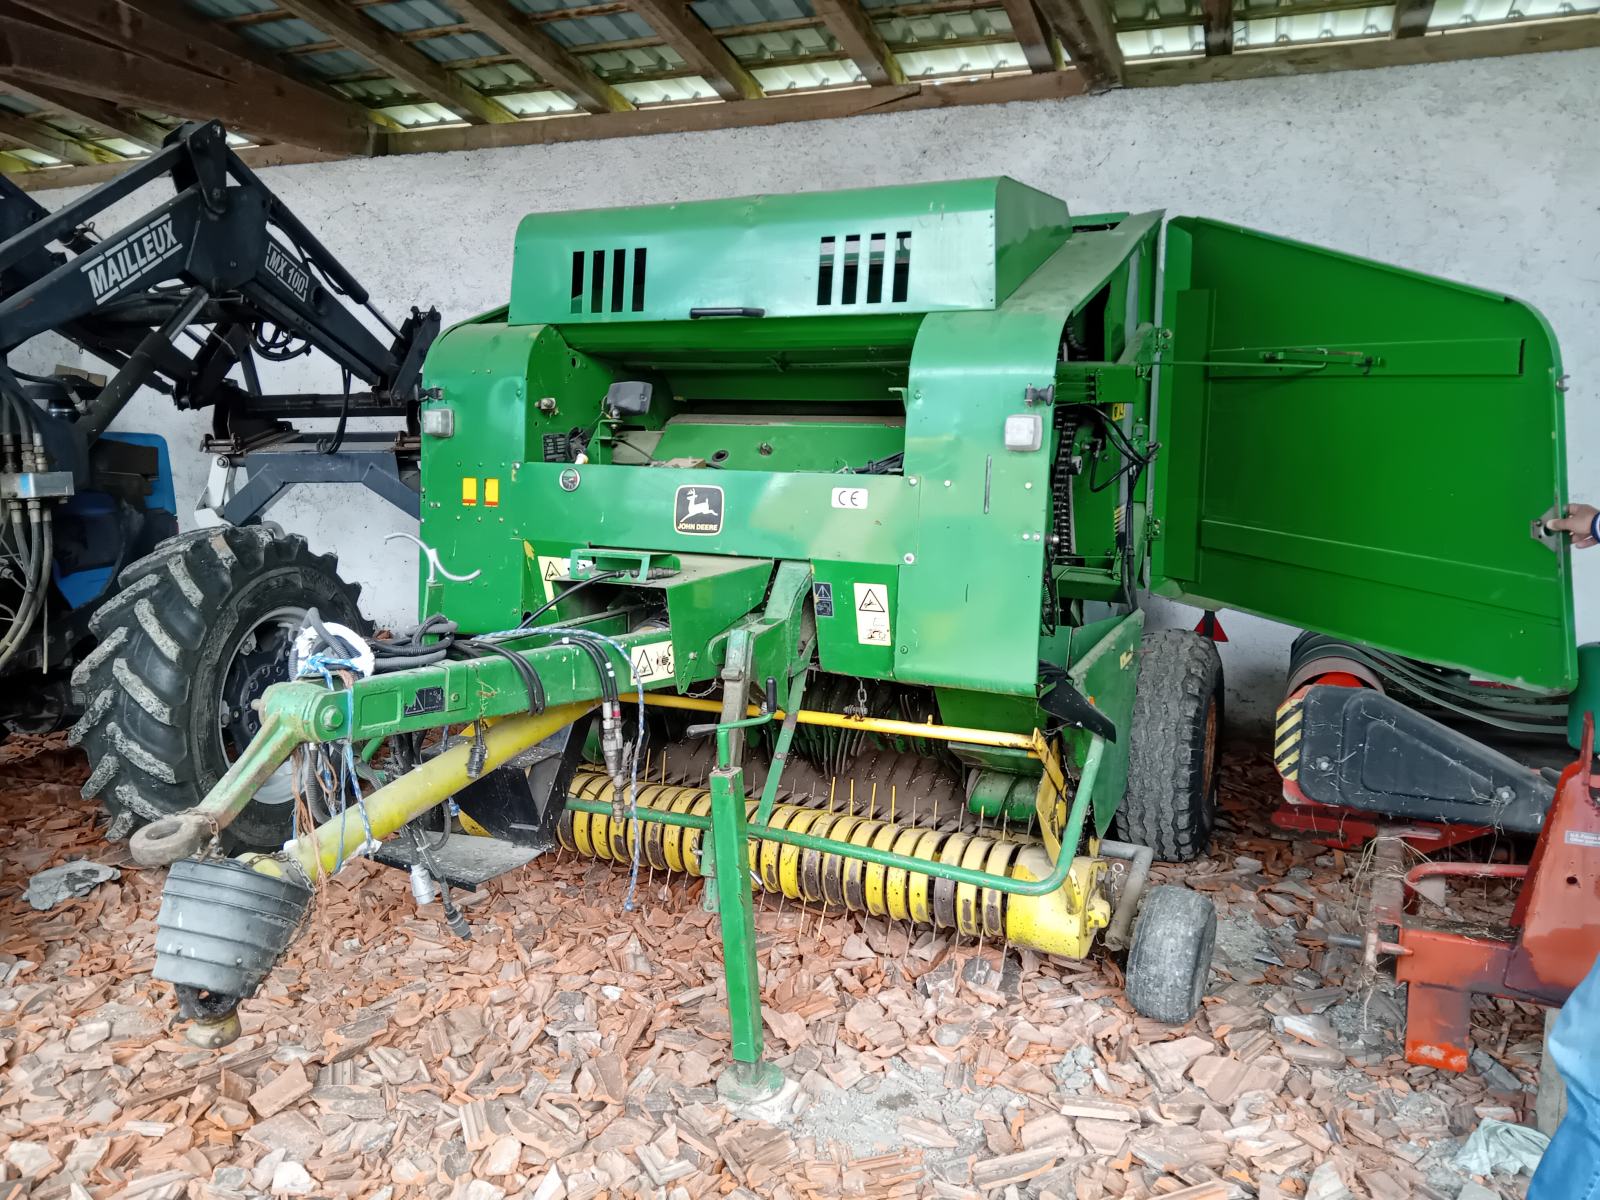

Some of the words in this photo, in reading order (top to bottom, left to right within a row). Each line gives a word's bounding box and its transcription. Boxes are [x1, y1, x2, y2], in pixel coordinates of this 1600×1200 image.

[88, 220, 178, 298] MAILLEUX
[269, 250, 288, 278] MX
[287, 267, 306, 293] 100
[838, 490, 860, 507] CE
[696, 523, 718, 531] DEERE
